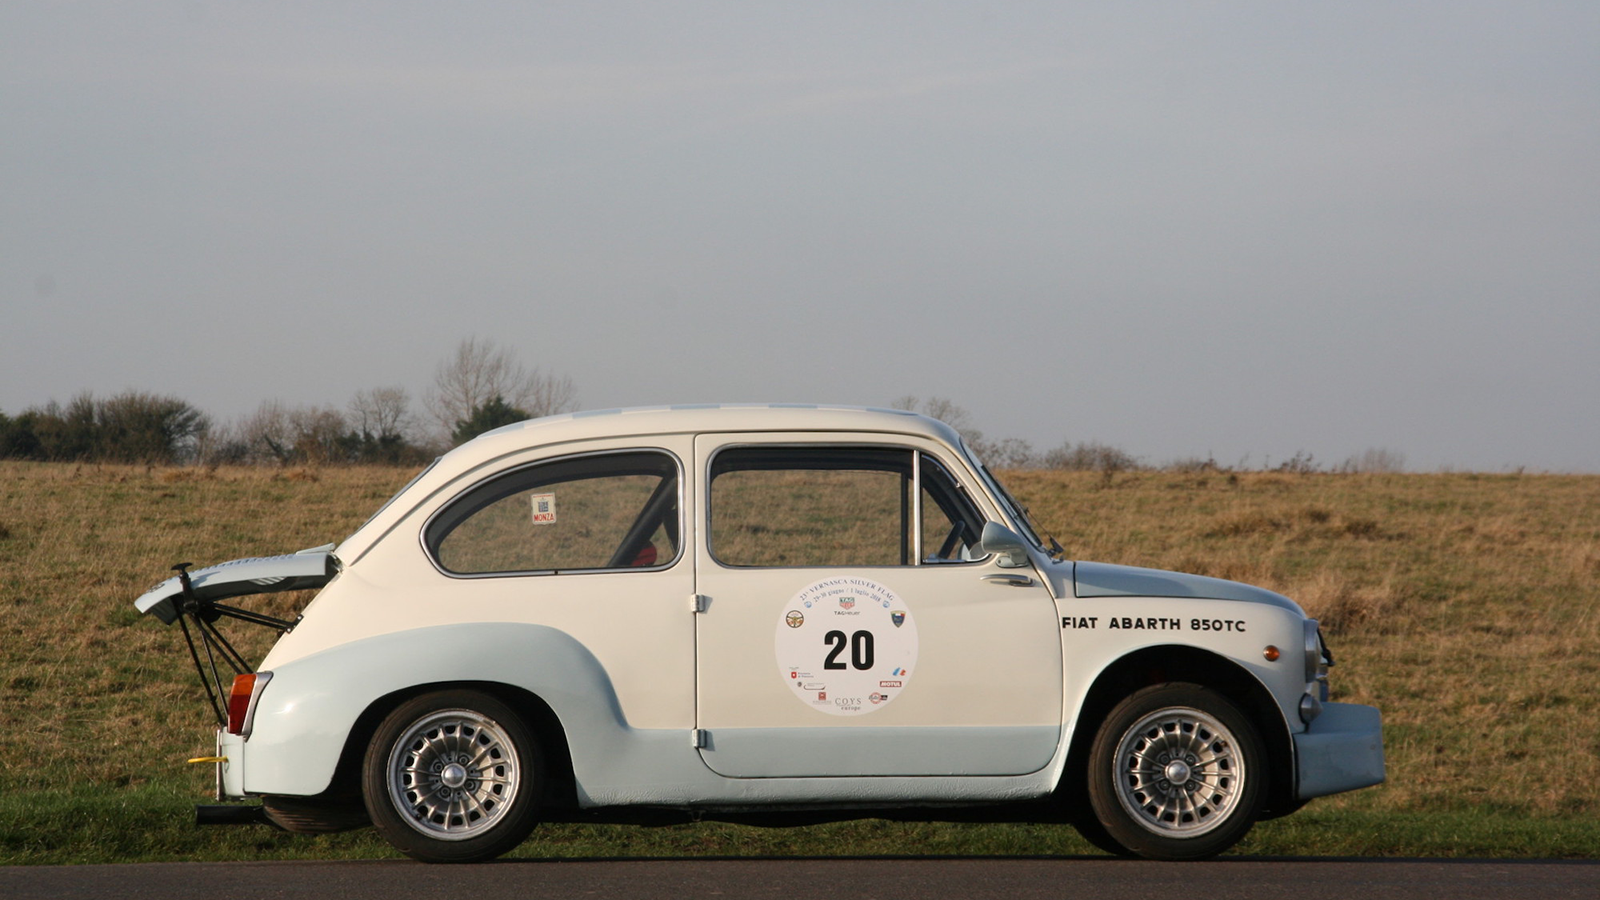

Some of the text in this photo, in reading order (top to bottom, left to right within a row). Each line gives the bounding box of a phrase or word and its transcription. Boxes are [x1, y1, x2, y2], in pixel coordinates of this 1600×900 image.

[533, 513, 554, 521] MONZA
[809, 579, 848, 593] VERNASCA
[850, 579, 877, 590] SILVER
[877, 586, 895, 601] FLAG
[854, 588, 870, 597] luglio
[1062, 617, 1246, 632] FIAT ABARTH 850TC
[824, 630, 875, 670] 20
